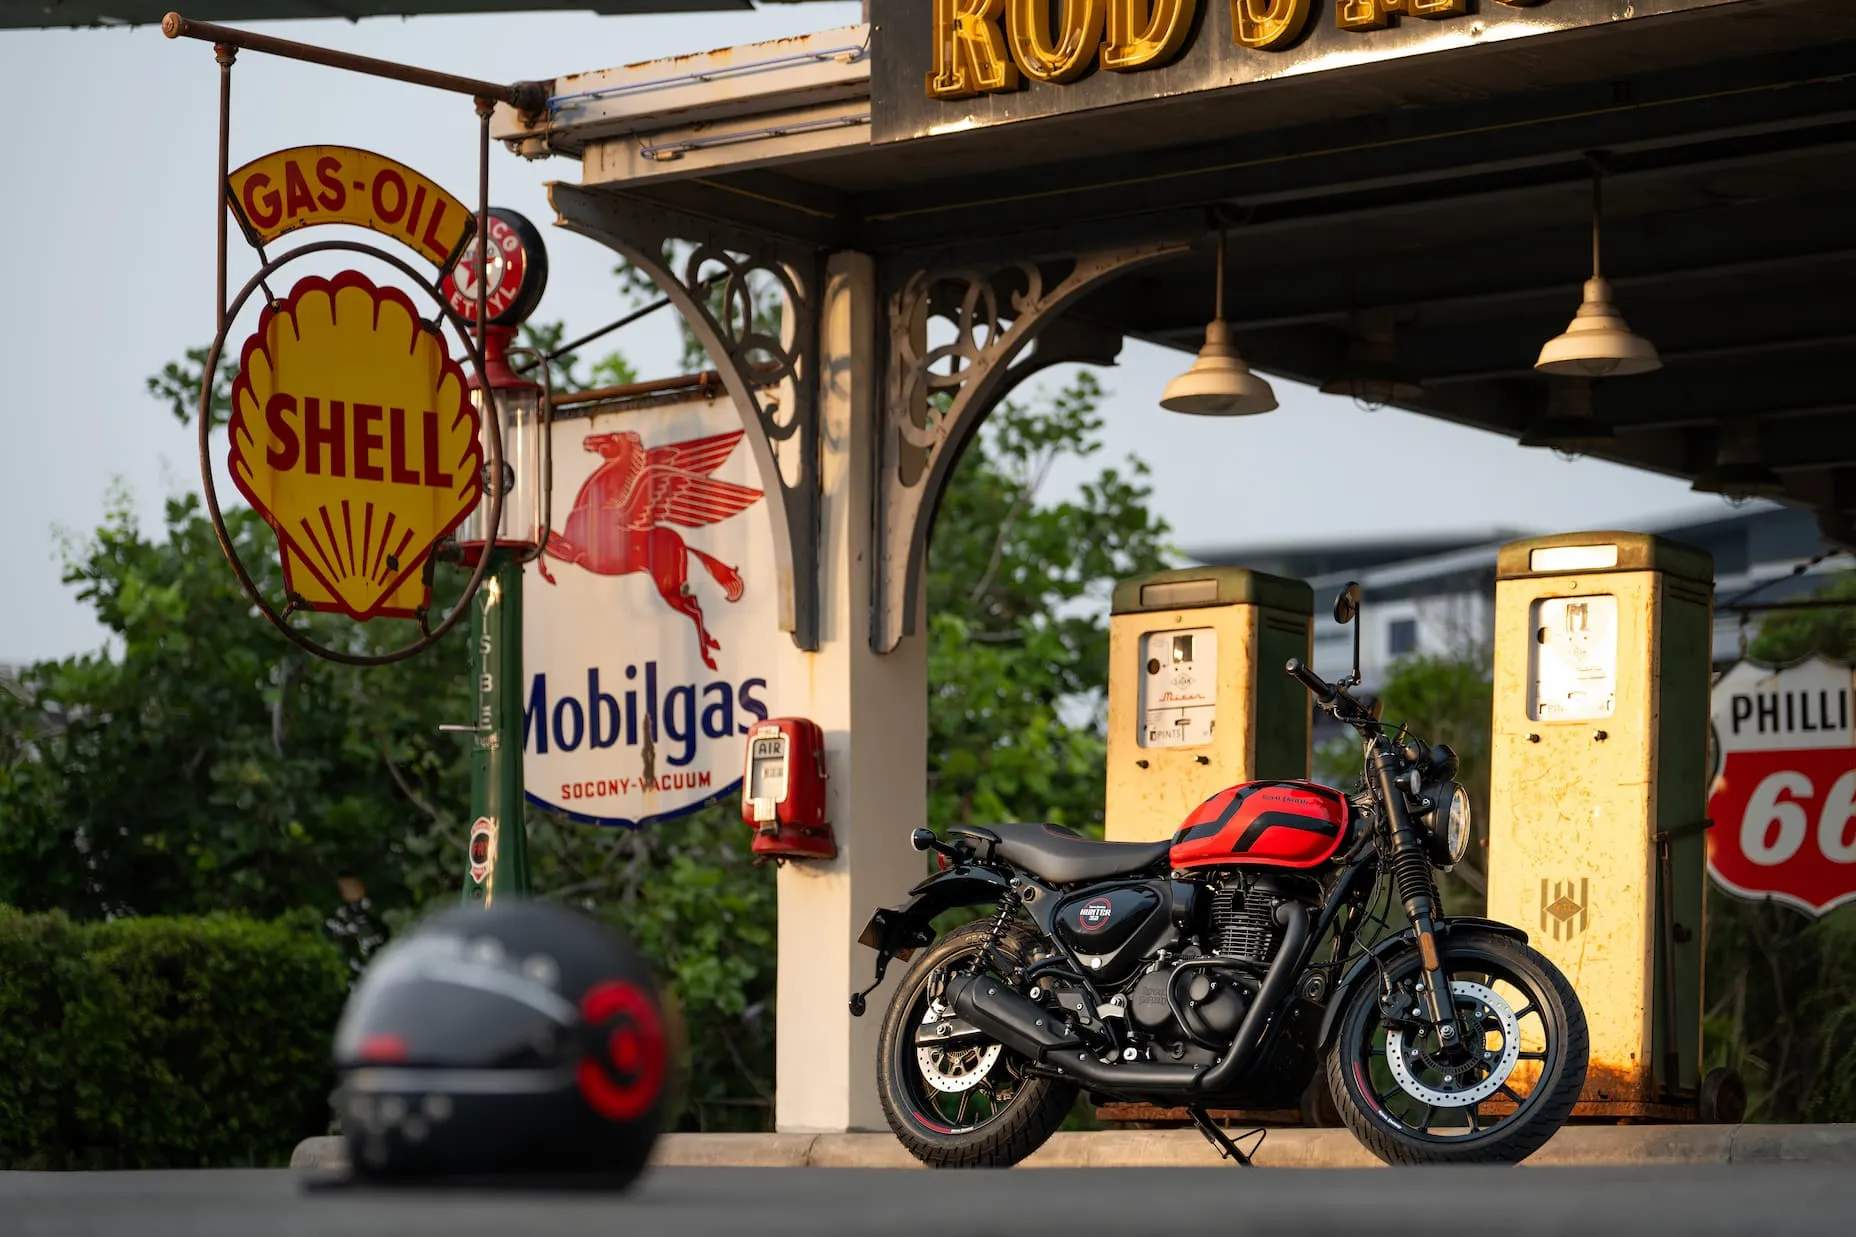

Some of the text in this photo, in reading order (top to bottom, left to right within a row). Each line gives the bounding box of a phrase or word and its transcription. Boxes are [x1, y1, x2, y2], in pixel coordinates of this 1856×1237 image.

[243, 156, 449, 260] GAS-OIL
[265, 393, 453, 488] SHELL
[1731, 689, 1856, 735] PHILLI
[758, 743, 781, 755] AIR
[561, 771, 711, 800] SOCONY-VACUUM
[1739, 769, 1856, 866] 66
